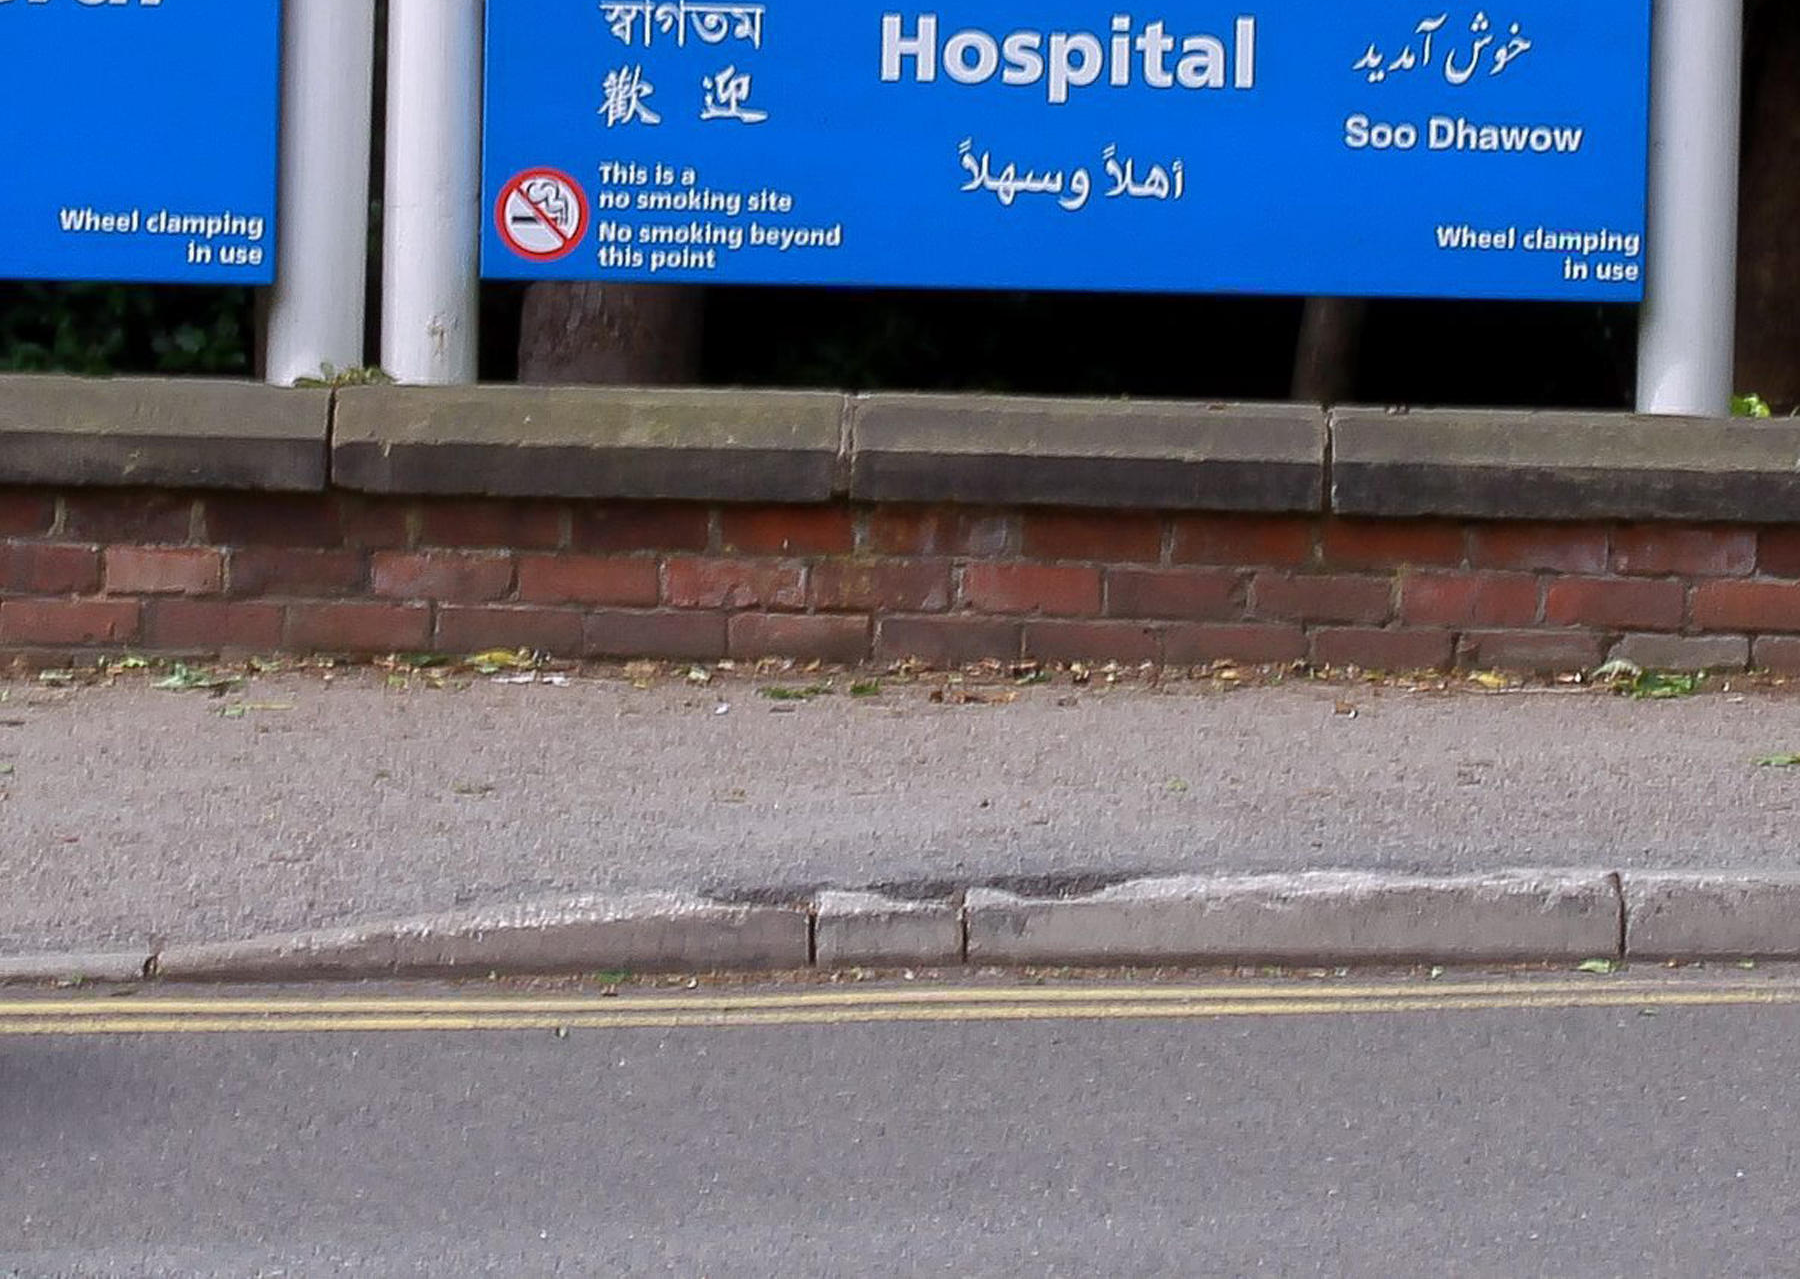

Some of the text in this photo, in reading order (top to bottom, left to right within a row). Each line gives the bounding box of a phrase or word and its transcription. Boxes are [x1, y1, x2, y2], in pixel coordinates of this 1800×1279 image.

[880, 13, 1255, 104] Hospital
[1443, 11, 1532, 85] خوش
[1345, 114, 1583, 152] Soo Dhawow
[598, 161, 696, 186] This is a
[599, 187, 792, 216] no smoking site
[59, 207, 264, 238] Wheel clamping
[598, 221, 841, 251] No smoking beyond
[187, 241, 263, 265] in use
[1436, 225, 1640, 255] Wheel clamping
[597, 245, 716, 272] this point
[1564, 256, 1639, 281] in use
